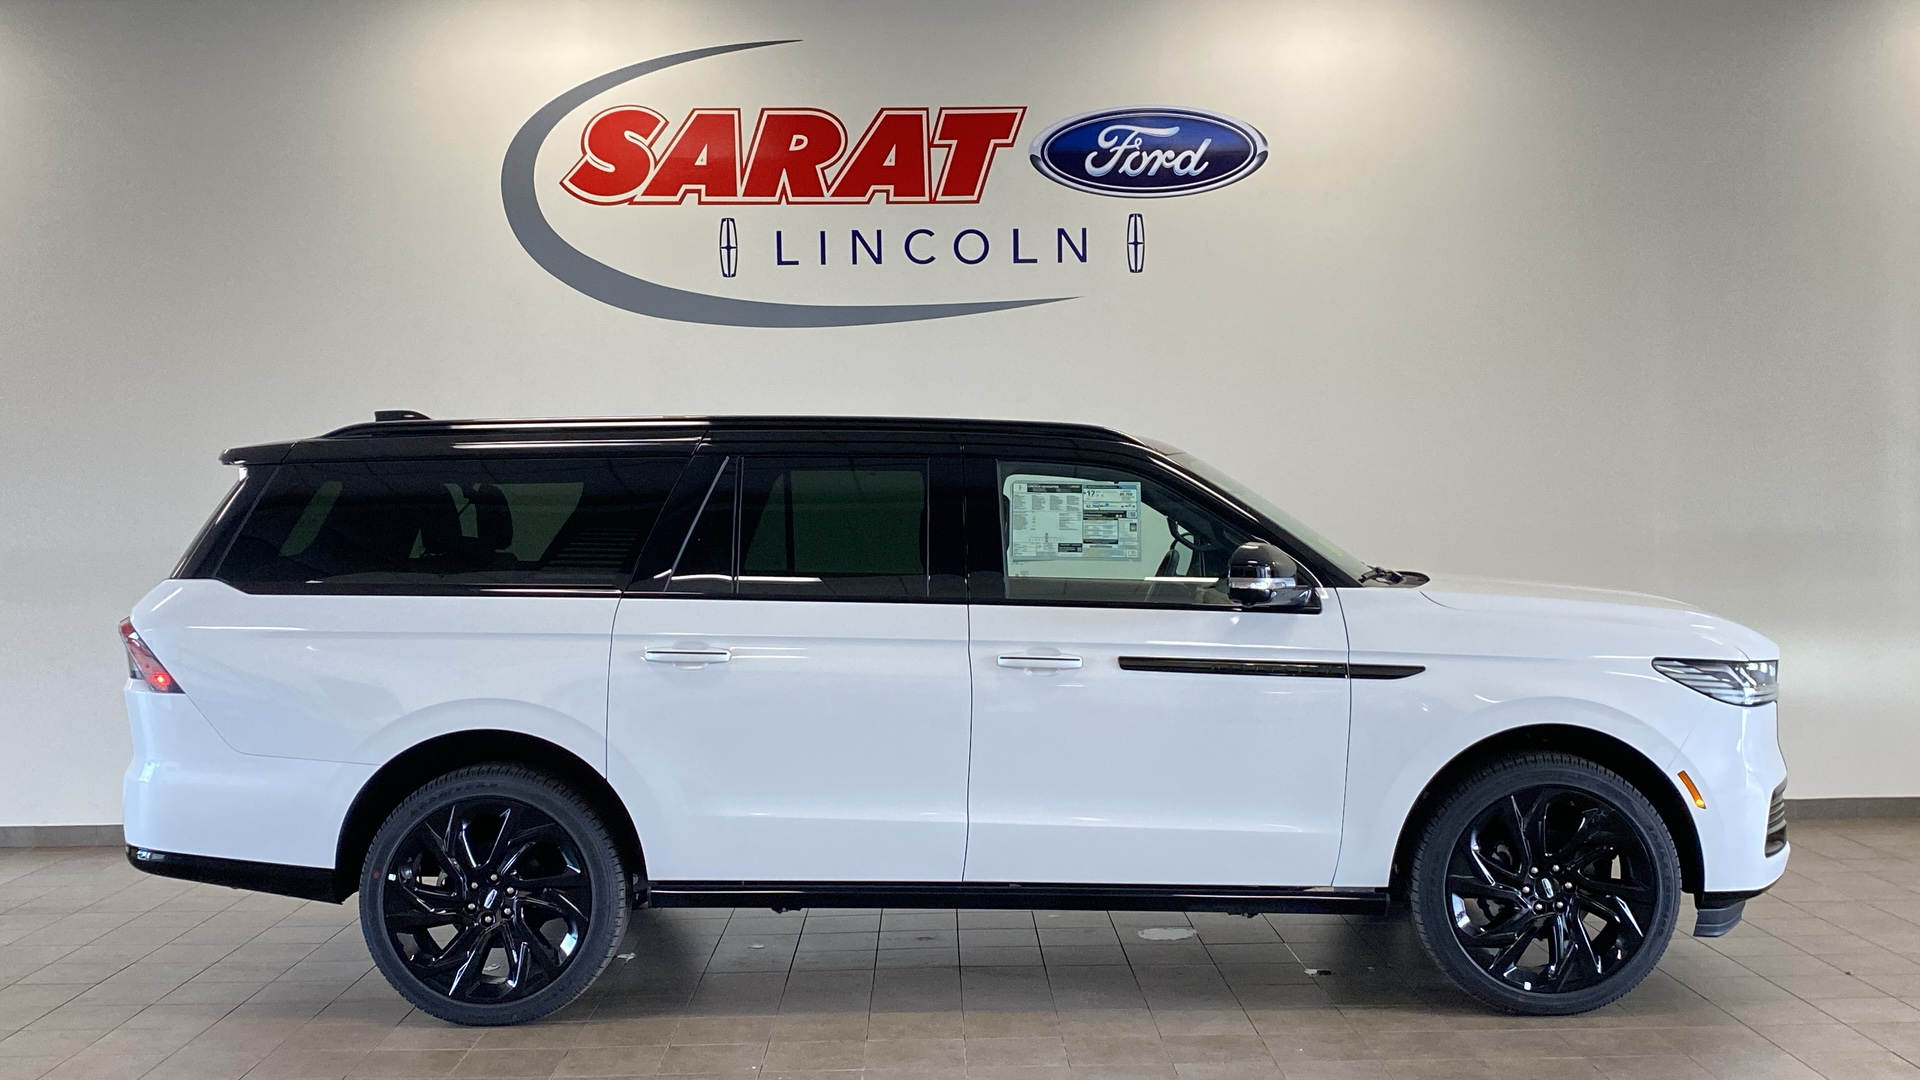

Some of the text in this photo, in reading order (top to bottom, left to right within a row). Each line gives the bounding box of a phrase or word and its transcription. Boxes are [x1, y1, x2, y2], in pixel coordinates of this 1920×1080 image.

[560, 104, 1026, 206] SARAT
[1085, 124, 1212, 177] Ford
[775, 227, 1089, 266] LINCOLN
